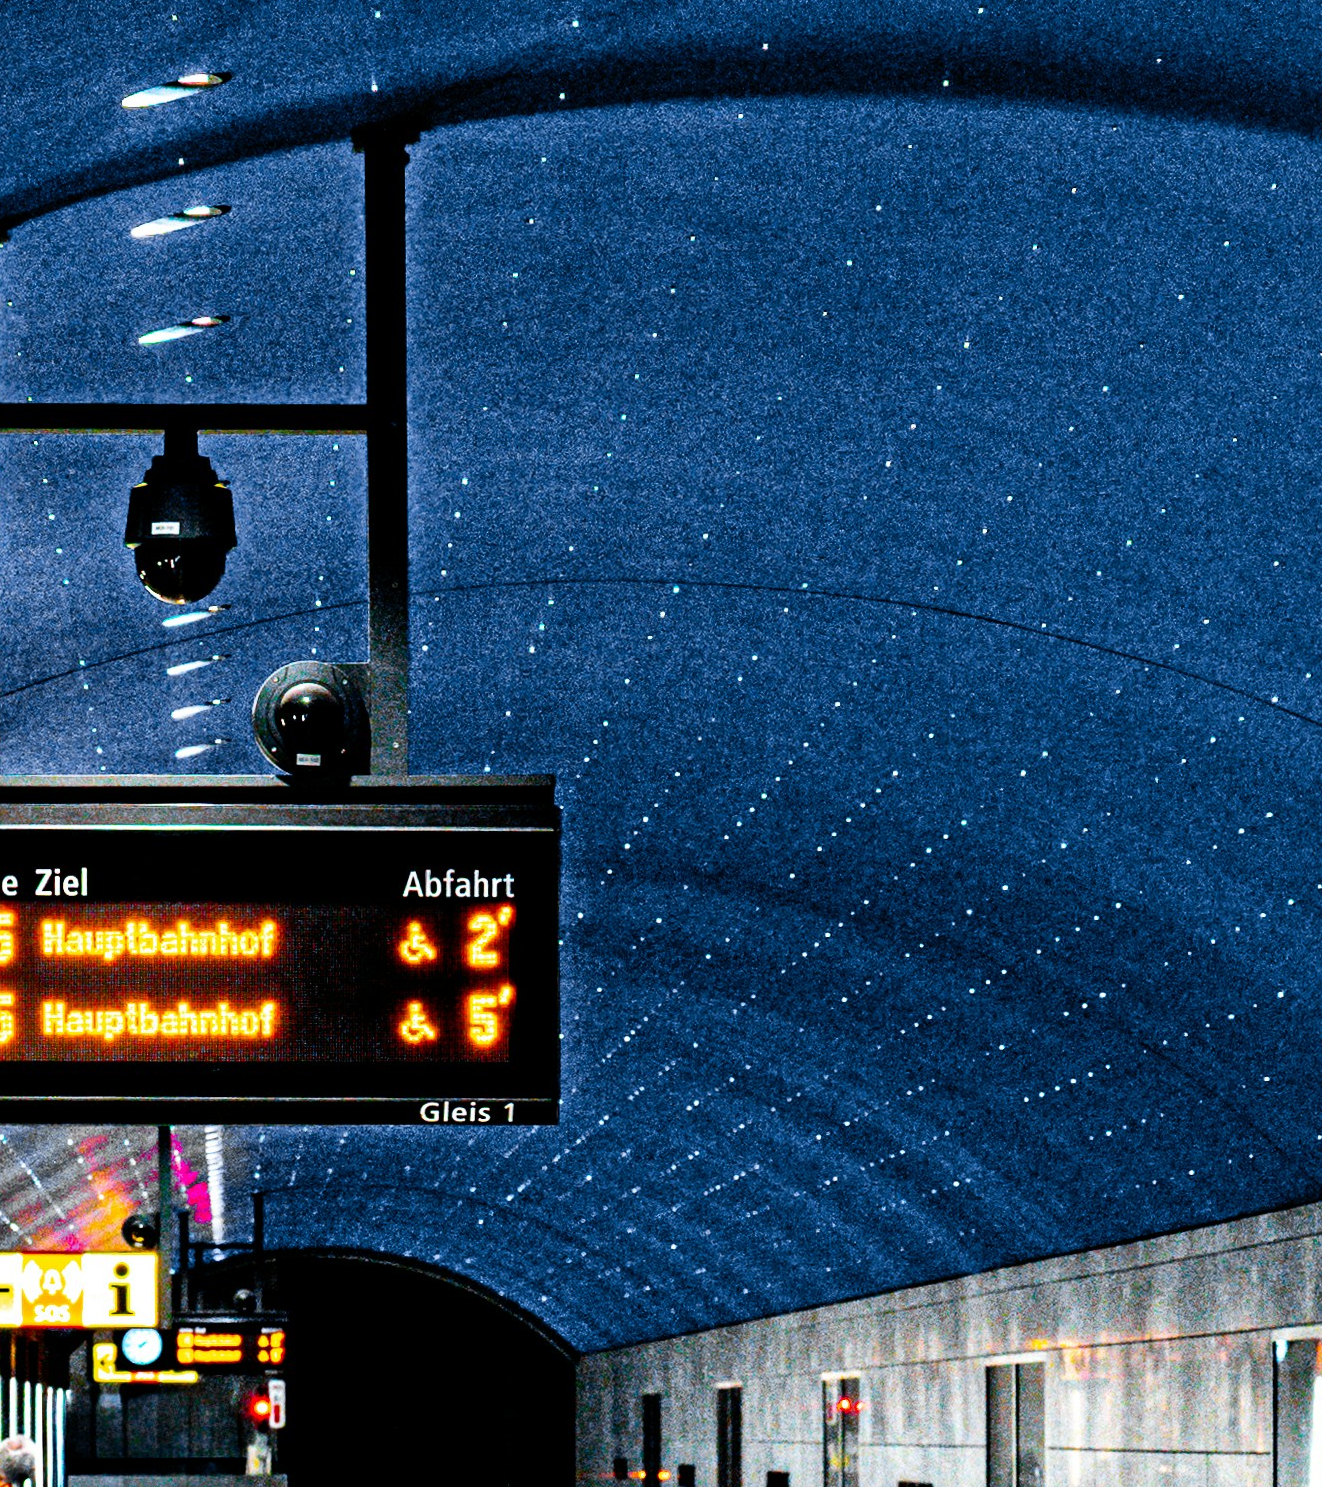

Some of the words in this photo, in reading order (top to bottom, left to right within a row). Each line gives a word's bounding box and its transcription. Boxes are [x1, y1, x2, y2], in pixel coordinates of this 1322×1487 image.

[34, 867, 88, 897] Ziel
[402, 868, 515, 898] Abfahrt
[40, 916, 277, 963] Hauptbahnhof
[40, 997, 277, 1043] Hauptbahnhof
[419, 1100, 491, 1123] Gleis
[503, 1101, 515, 1123] 1
[34, 1304, 71, 1323] SOS
